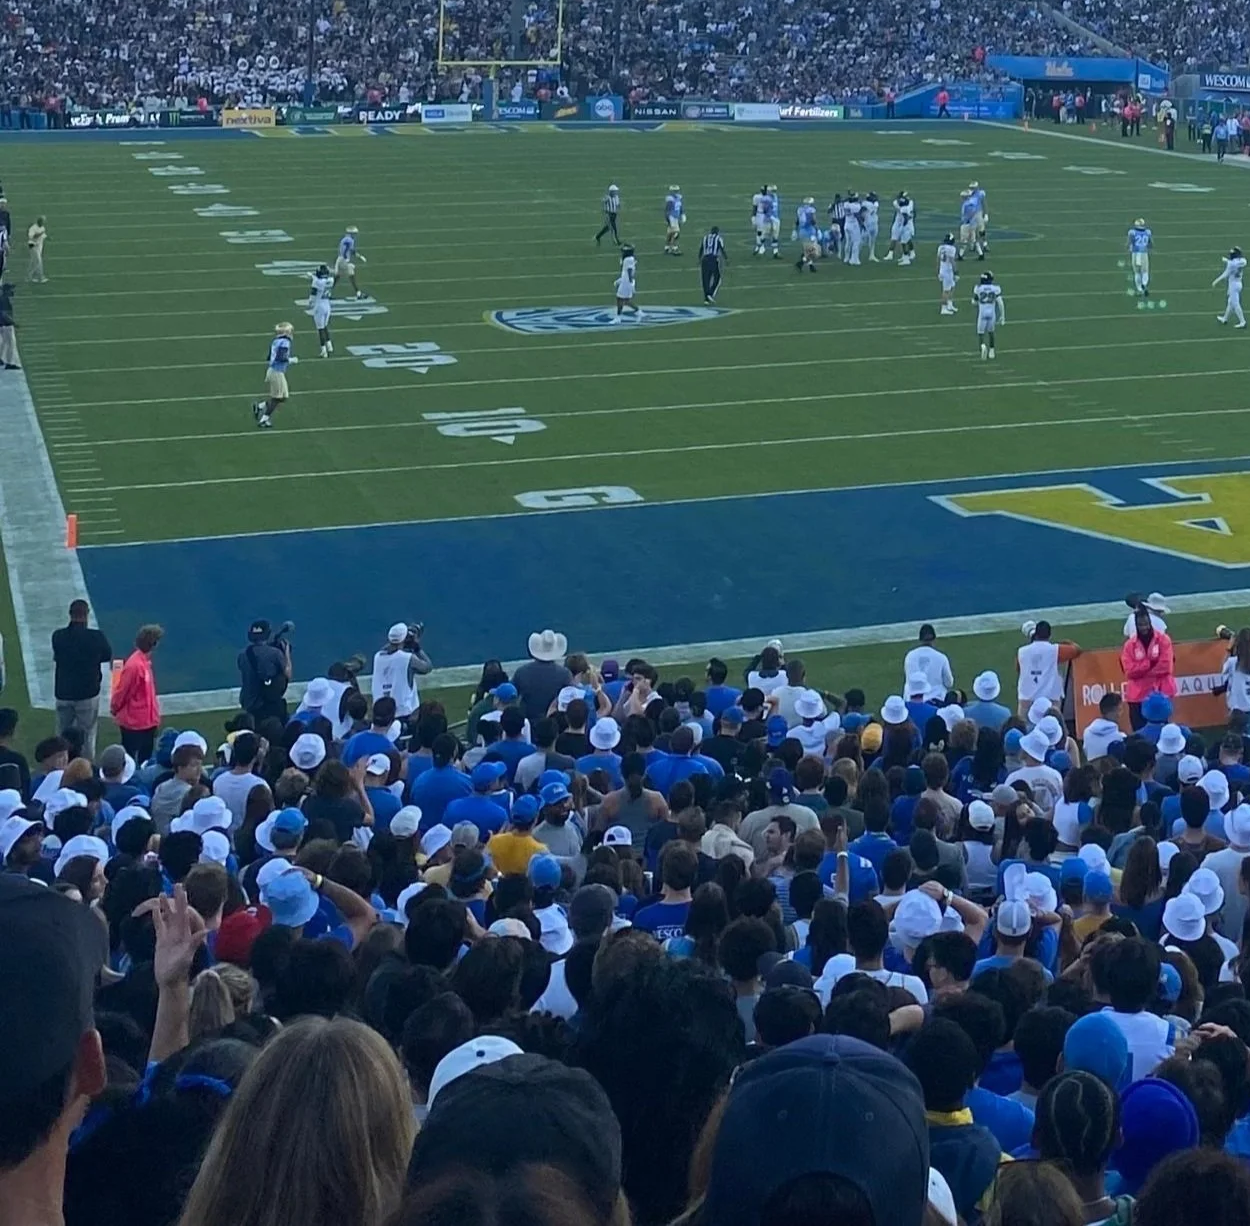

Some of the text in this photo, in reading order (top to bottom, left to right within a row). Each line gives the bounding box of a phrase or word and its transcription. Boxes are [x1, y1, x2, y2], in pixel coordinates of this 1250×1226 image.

[1205, 74, 1246, 87] WESCOM
[634, 108, 677, 116] NISSAN
[794, 106, 838, 118] Fertilizers
[226, 114, 271, 125] nextiva
[346, 342, 458, 368] 20
[422, 407, 547, 437] 10
[514, 485, 645, 509] G
